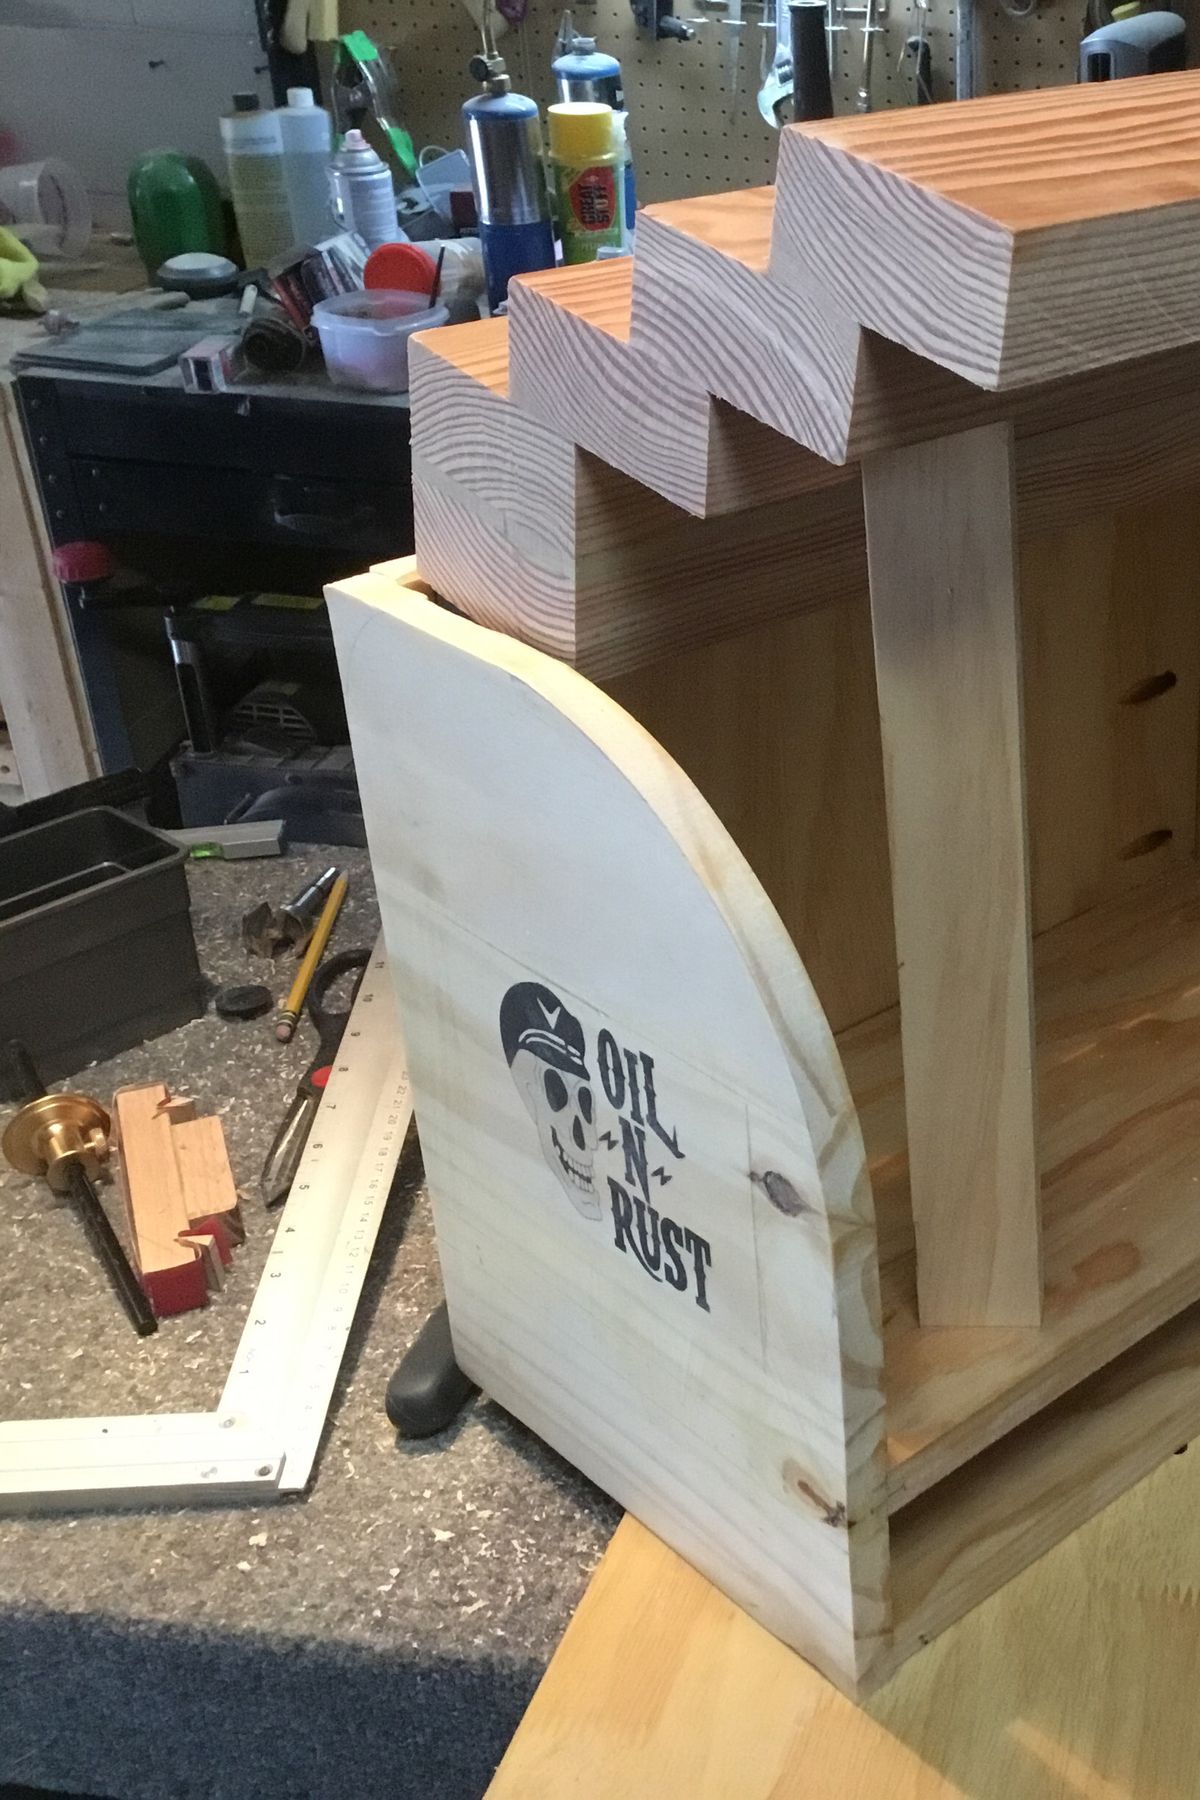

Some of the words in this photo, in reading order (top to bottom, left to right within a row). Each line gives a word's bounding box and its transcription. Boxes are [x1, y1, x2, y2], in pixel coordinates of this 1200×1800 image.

[578, 183, 596, 224] GREAT
[595, 185, 609, 223] STUFF
[597, 1028, 685, 1159] OIL
[606, 1175, 712, 1313] RUST
